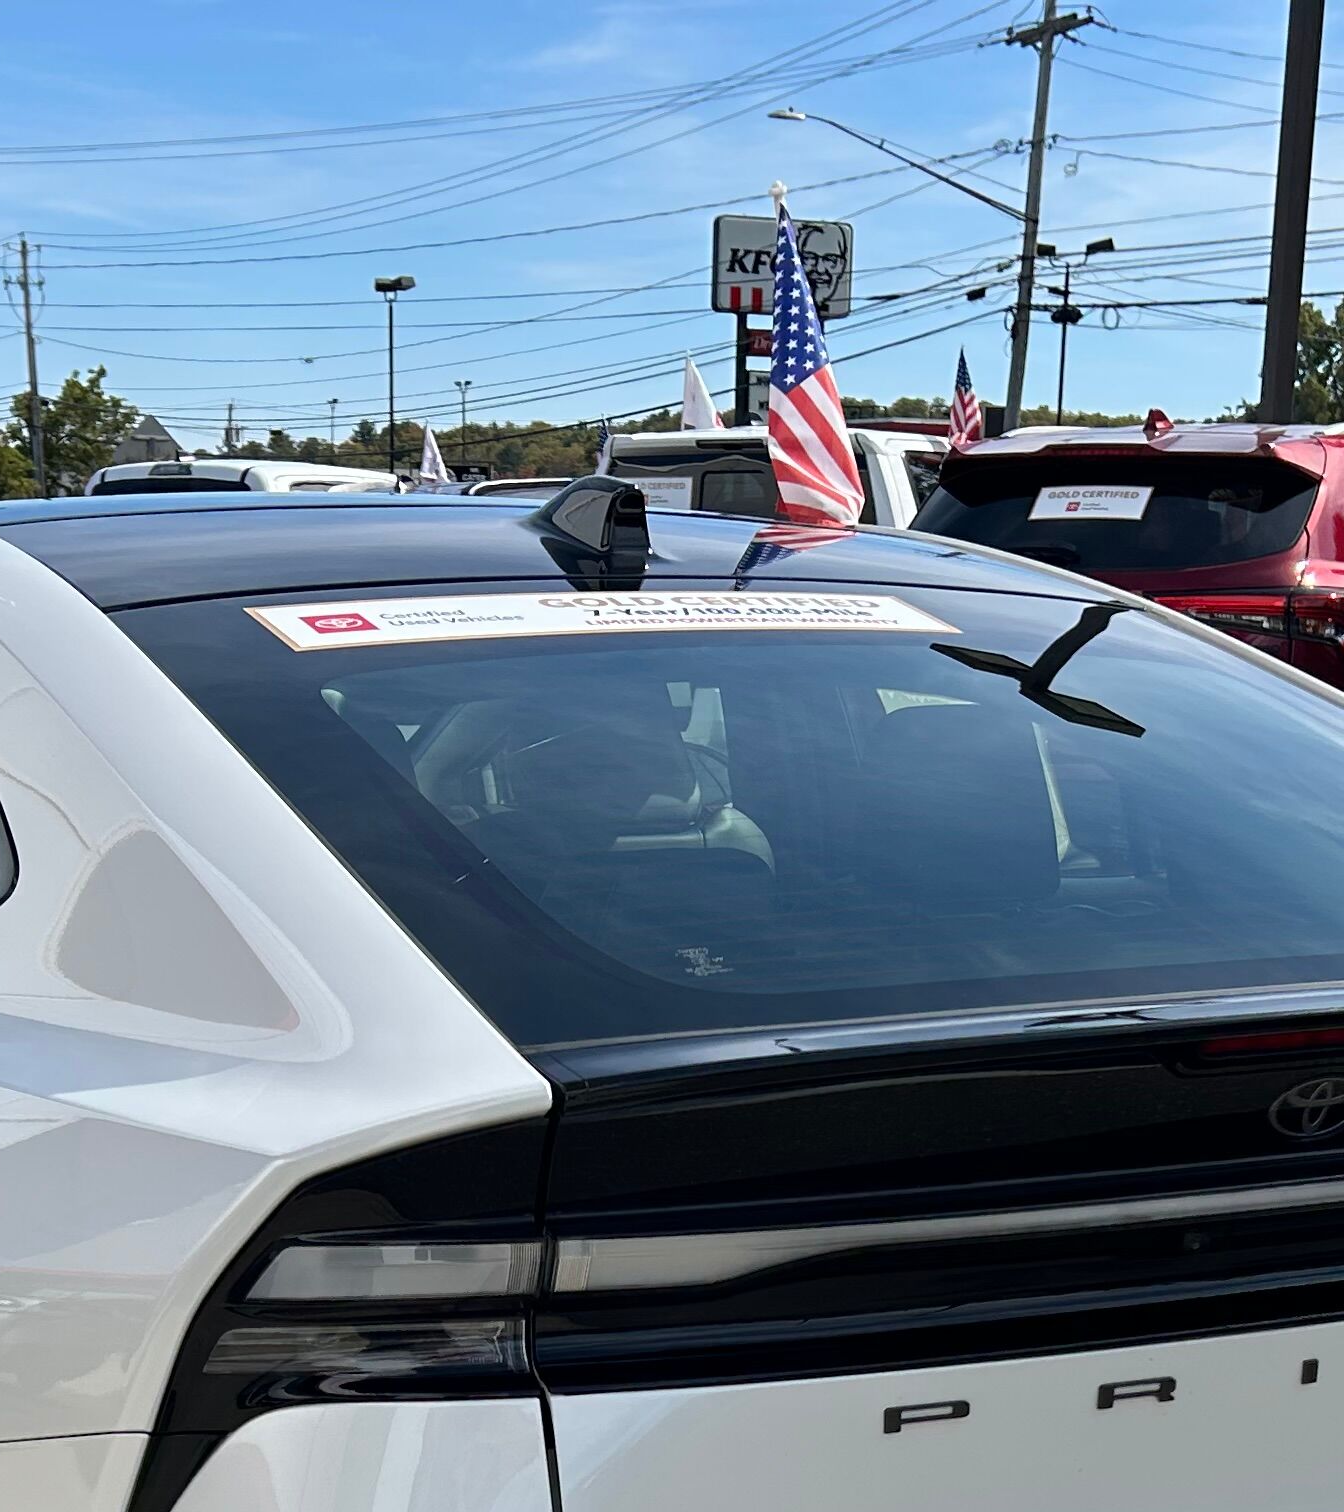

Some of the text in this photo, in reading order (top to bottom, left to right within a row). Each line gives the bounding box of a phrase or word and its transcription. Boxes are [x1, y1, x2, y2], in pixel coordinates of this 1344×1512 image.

[726, 248, 777, 275] KF
[1048, 490, 1139, 499] GOLD CERTIFIED
[538, 596, 880, 608] GOLD CERTIFIED
[379, 609, 466, 620] Certified
[388, 615, 525, 626] Used Vehicles
[585, 618, 664, 626] LIMITED
